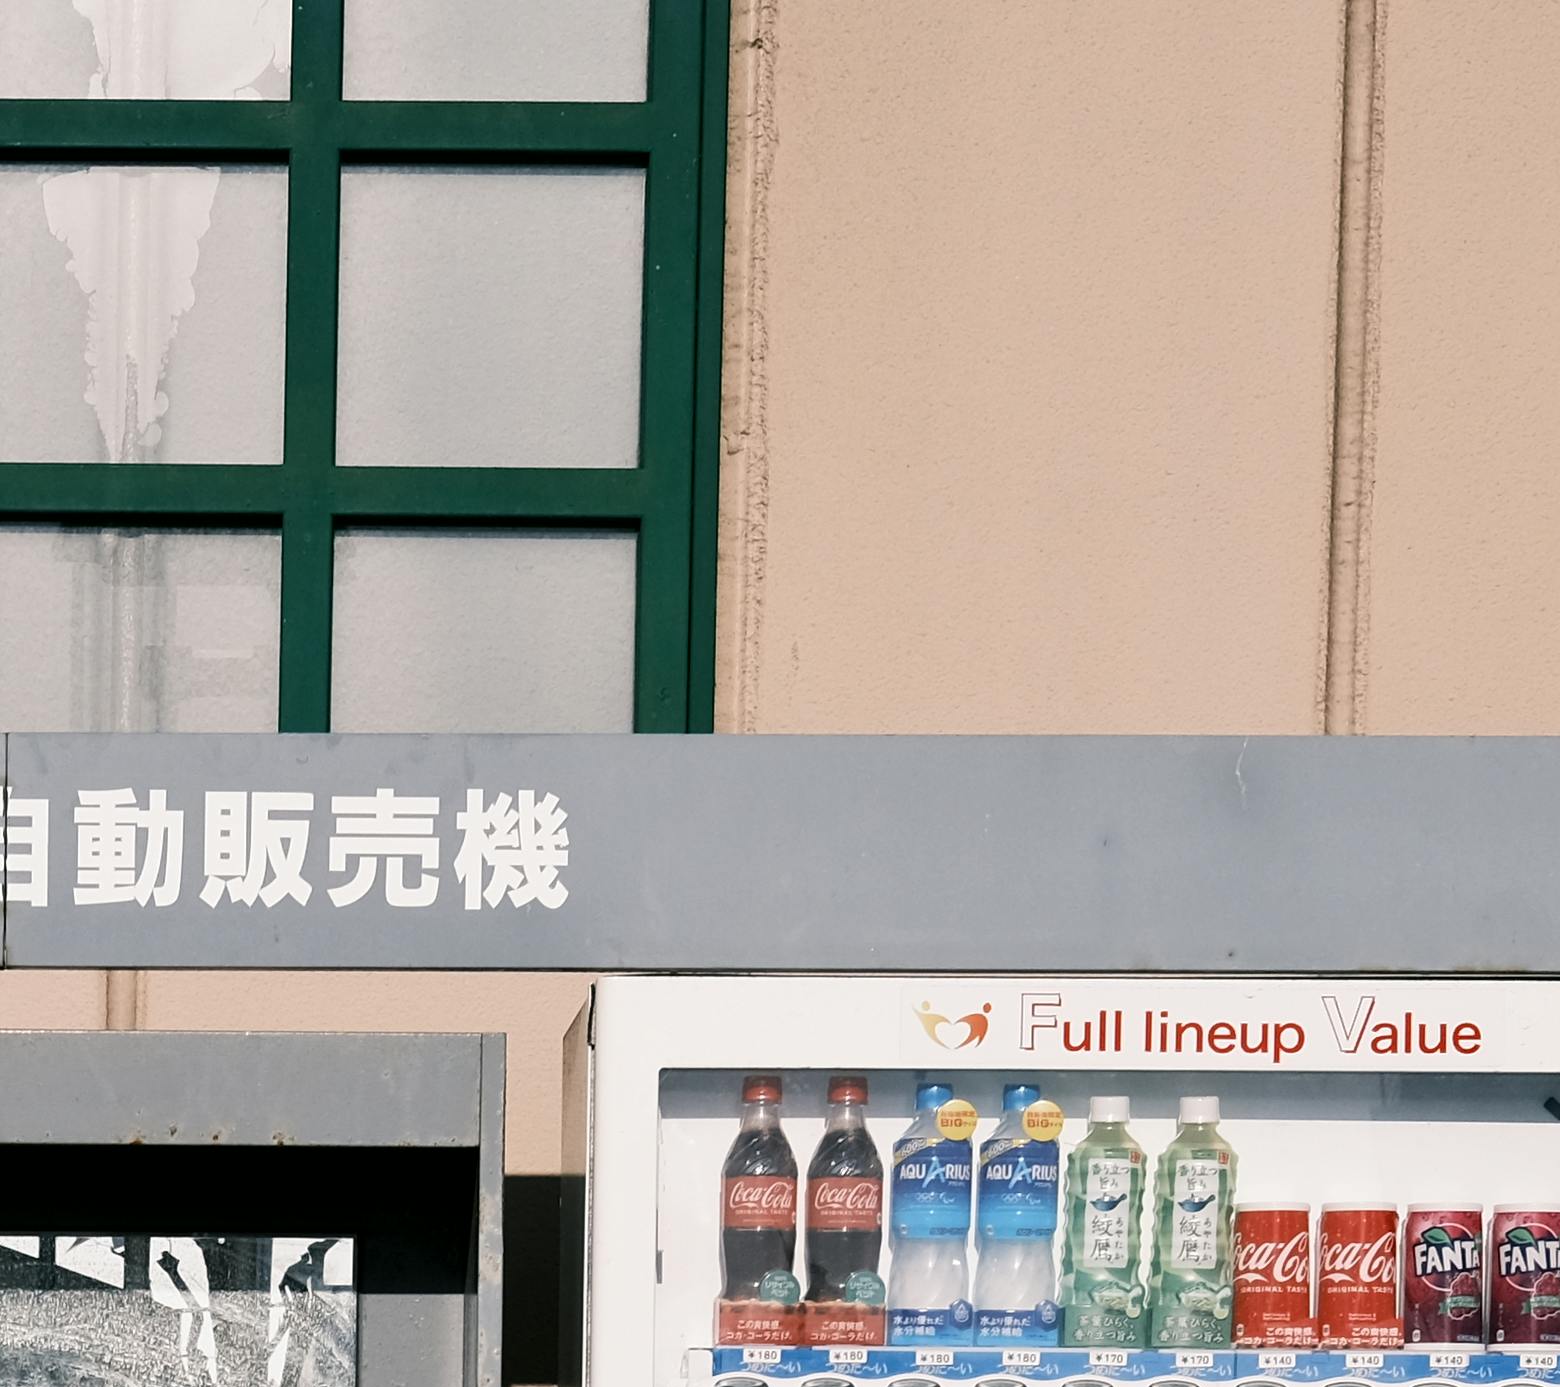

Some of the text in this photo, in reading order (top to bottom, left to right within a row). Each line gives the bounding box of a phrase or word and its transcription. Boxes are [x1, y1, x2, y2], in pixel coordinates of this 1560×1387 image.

[1019, 992, 1482, 1064] Full lineup Value
[900, 1157, 971, 1188] AQUARIUS
[986, 1161, 1057, 1188] AQUARIUS
[1415, 1241, 1480, 1275] FANTA
[1095, 1353, 1124, 1363] ¥170
